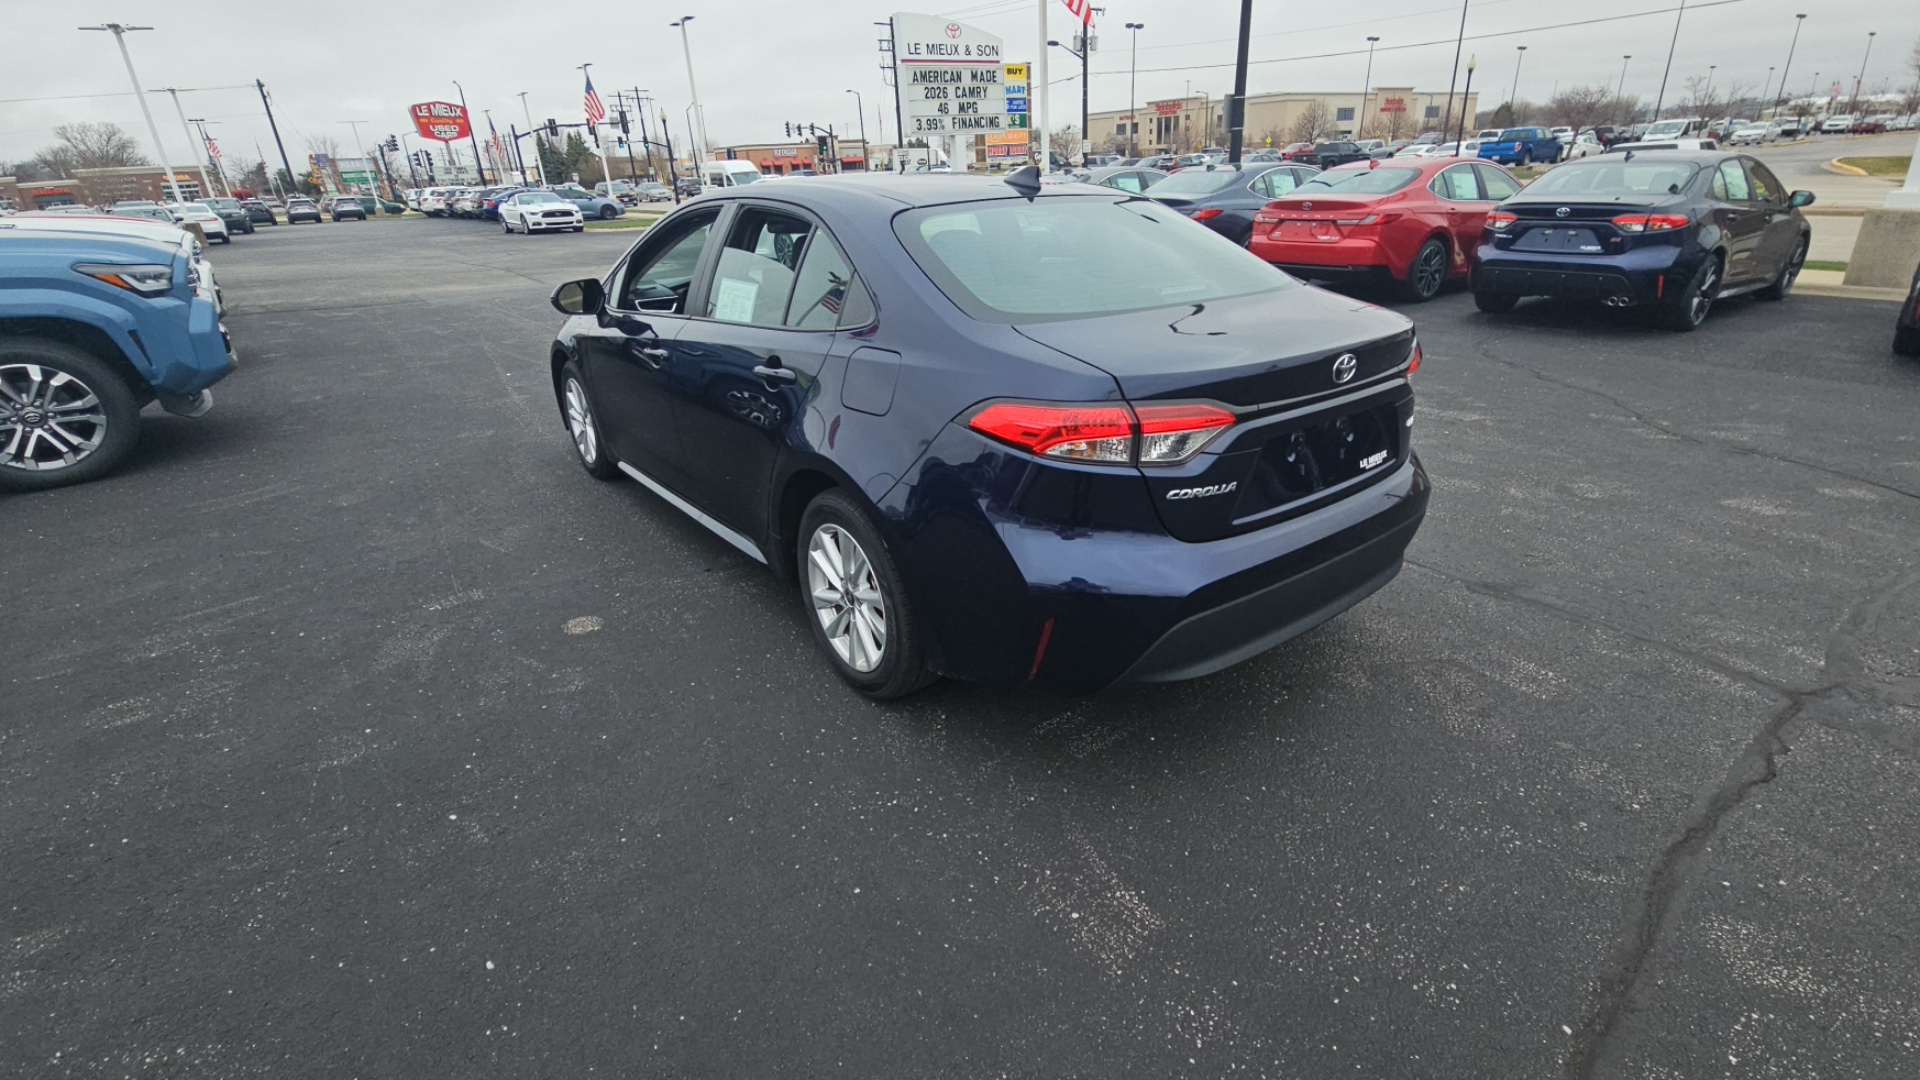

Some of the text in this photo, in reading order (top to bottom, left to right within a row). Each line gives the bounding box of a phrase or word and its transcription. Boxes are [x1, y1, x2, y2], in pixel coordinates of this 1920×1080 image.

[906, 43, 999, 57] LE MIEUX & SON
[912, 70, 997, 83] AMERICAN MADE
[924, 86, 988, 99] 2026 CAMRY
[416, 103, 463, 117] LE MIEUX
[937, 101, 978, 114] 46 MPG
[430, 124, 459, 132] USED
[915, 116, 1000, 131] 3.99% FINANCING
[435, 131, 458, 139] CARS
[1360, 458, 1368, 468] LE
[1166, 481, 1237, 500] COROLLA
